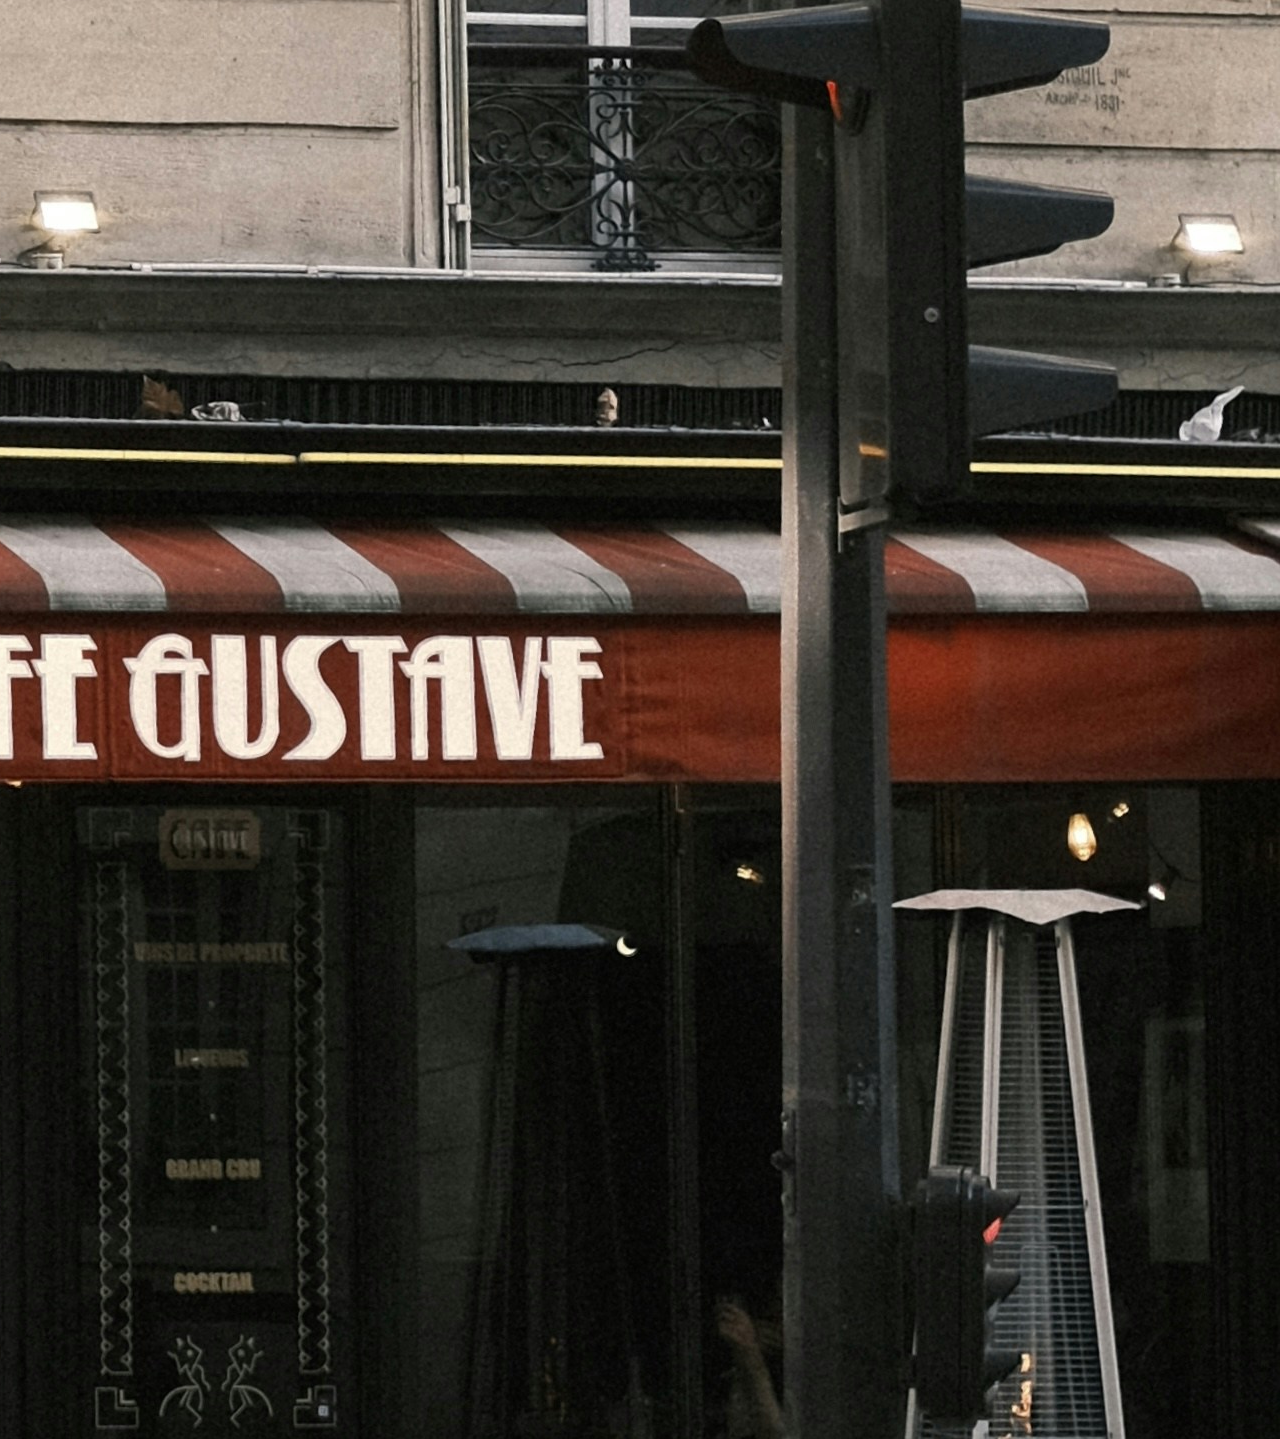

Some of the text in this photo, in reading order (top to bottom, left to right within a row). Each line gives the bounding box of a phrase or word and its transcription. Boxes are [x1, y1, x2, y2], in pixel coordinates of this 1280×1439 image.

[124, 632, 605, 761] GUSTAVE
[165, 1158, 223, 1180] GRAND
[173, 1271, 255, 1294] COCKTAIL
